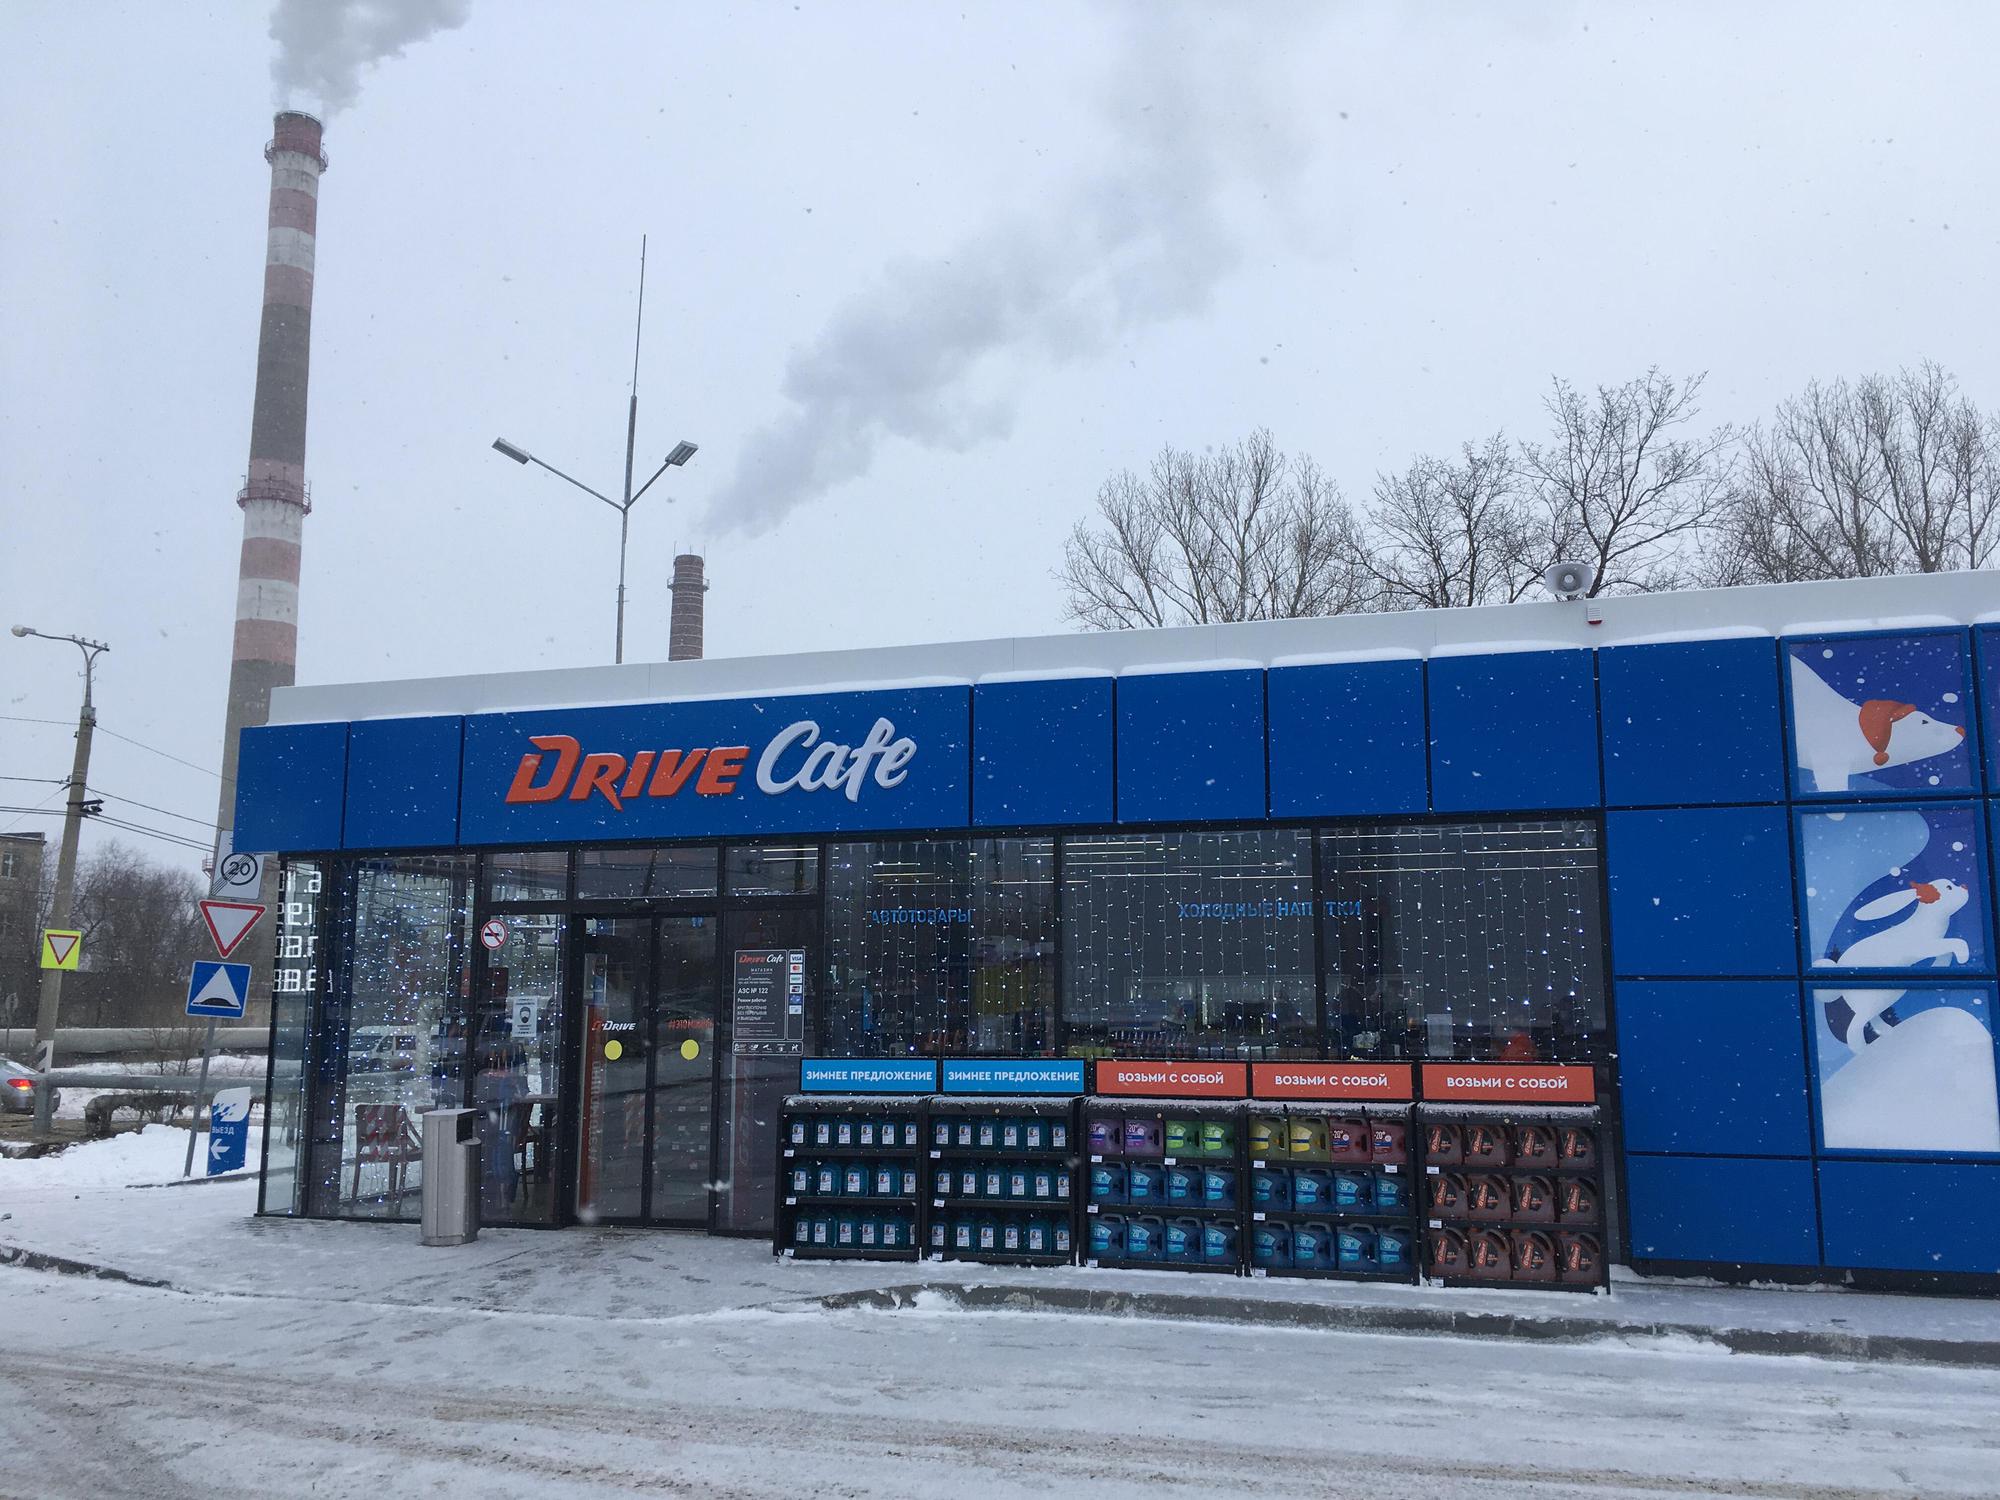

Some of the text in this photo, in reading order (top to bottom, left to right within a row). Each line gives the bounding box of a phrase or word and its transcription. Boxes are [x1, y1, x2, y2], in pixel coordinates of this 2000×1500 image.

[756, 717, 917, 802] Cafe
[228, 861, 250, 876] 20
[872, 909, 971, 923] АВТОТОВАРЫ
[1178, 901, 1361, 919] ХОЛОДНЫЕ НАПТКИ
[766, 954, 784, 963] Cafe
[806, 1071, 932, 1082] ЗИМНЕЕ ПРЕДЛОЖЕНИЕ
[948, 1071, 1080, 1082] ЗИМНЕЕ ПРЕДЛОЖЕНИЕ
[1118, 1071, 1224, 1084] ВОЗЬМИ С СОБОЙ
[1275, 1073, 1388, 1086] ВОЗЬМИ С СОБОЙ
[1446, 1076, 1568, 1089] ВОЗЬМИ С СОБОЙ
